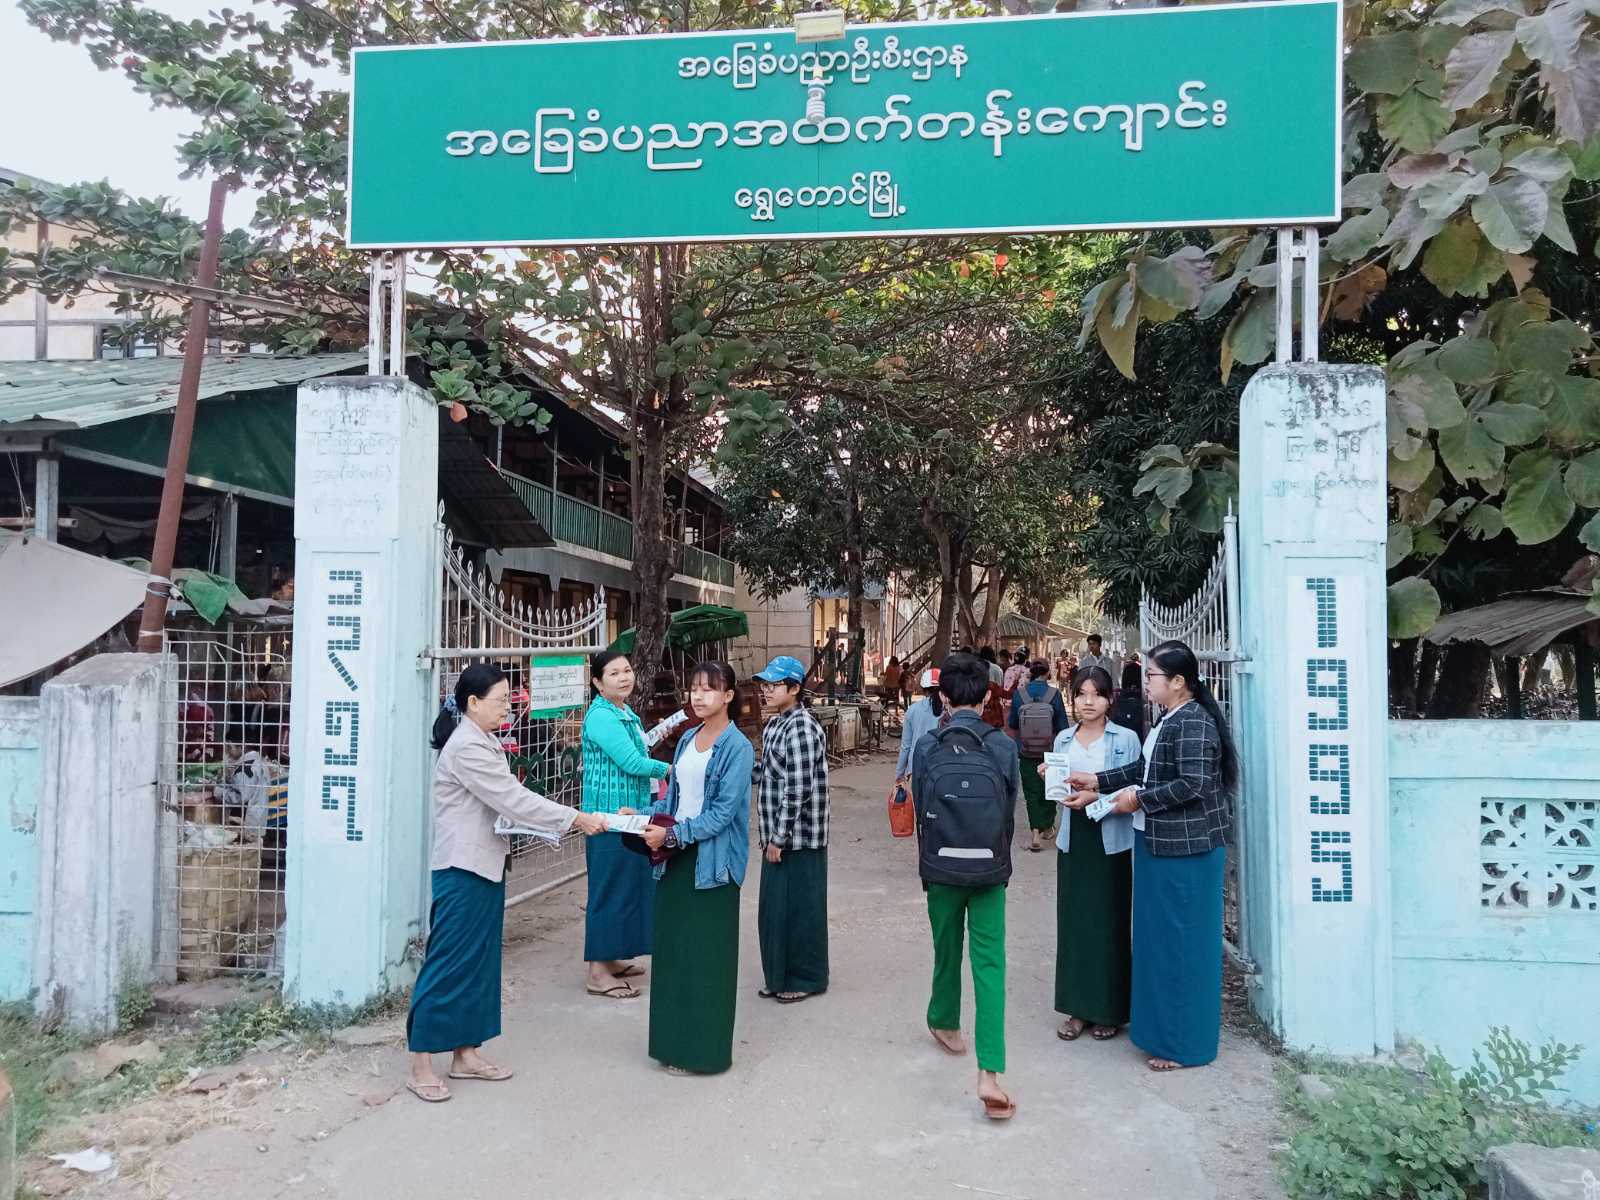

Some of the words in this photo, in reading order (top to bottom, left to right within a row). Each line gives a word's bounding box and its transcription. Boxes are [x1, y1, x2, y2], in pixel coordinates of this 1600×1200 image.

[445, 80, 1228, 174] အခြေခံပညာအထက်တန်းကျောင်း
[1306, 577, 1353, 903] 1995
